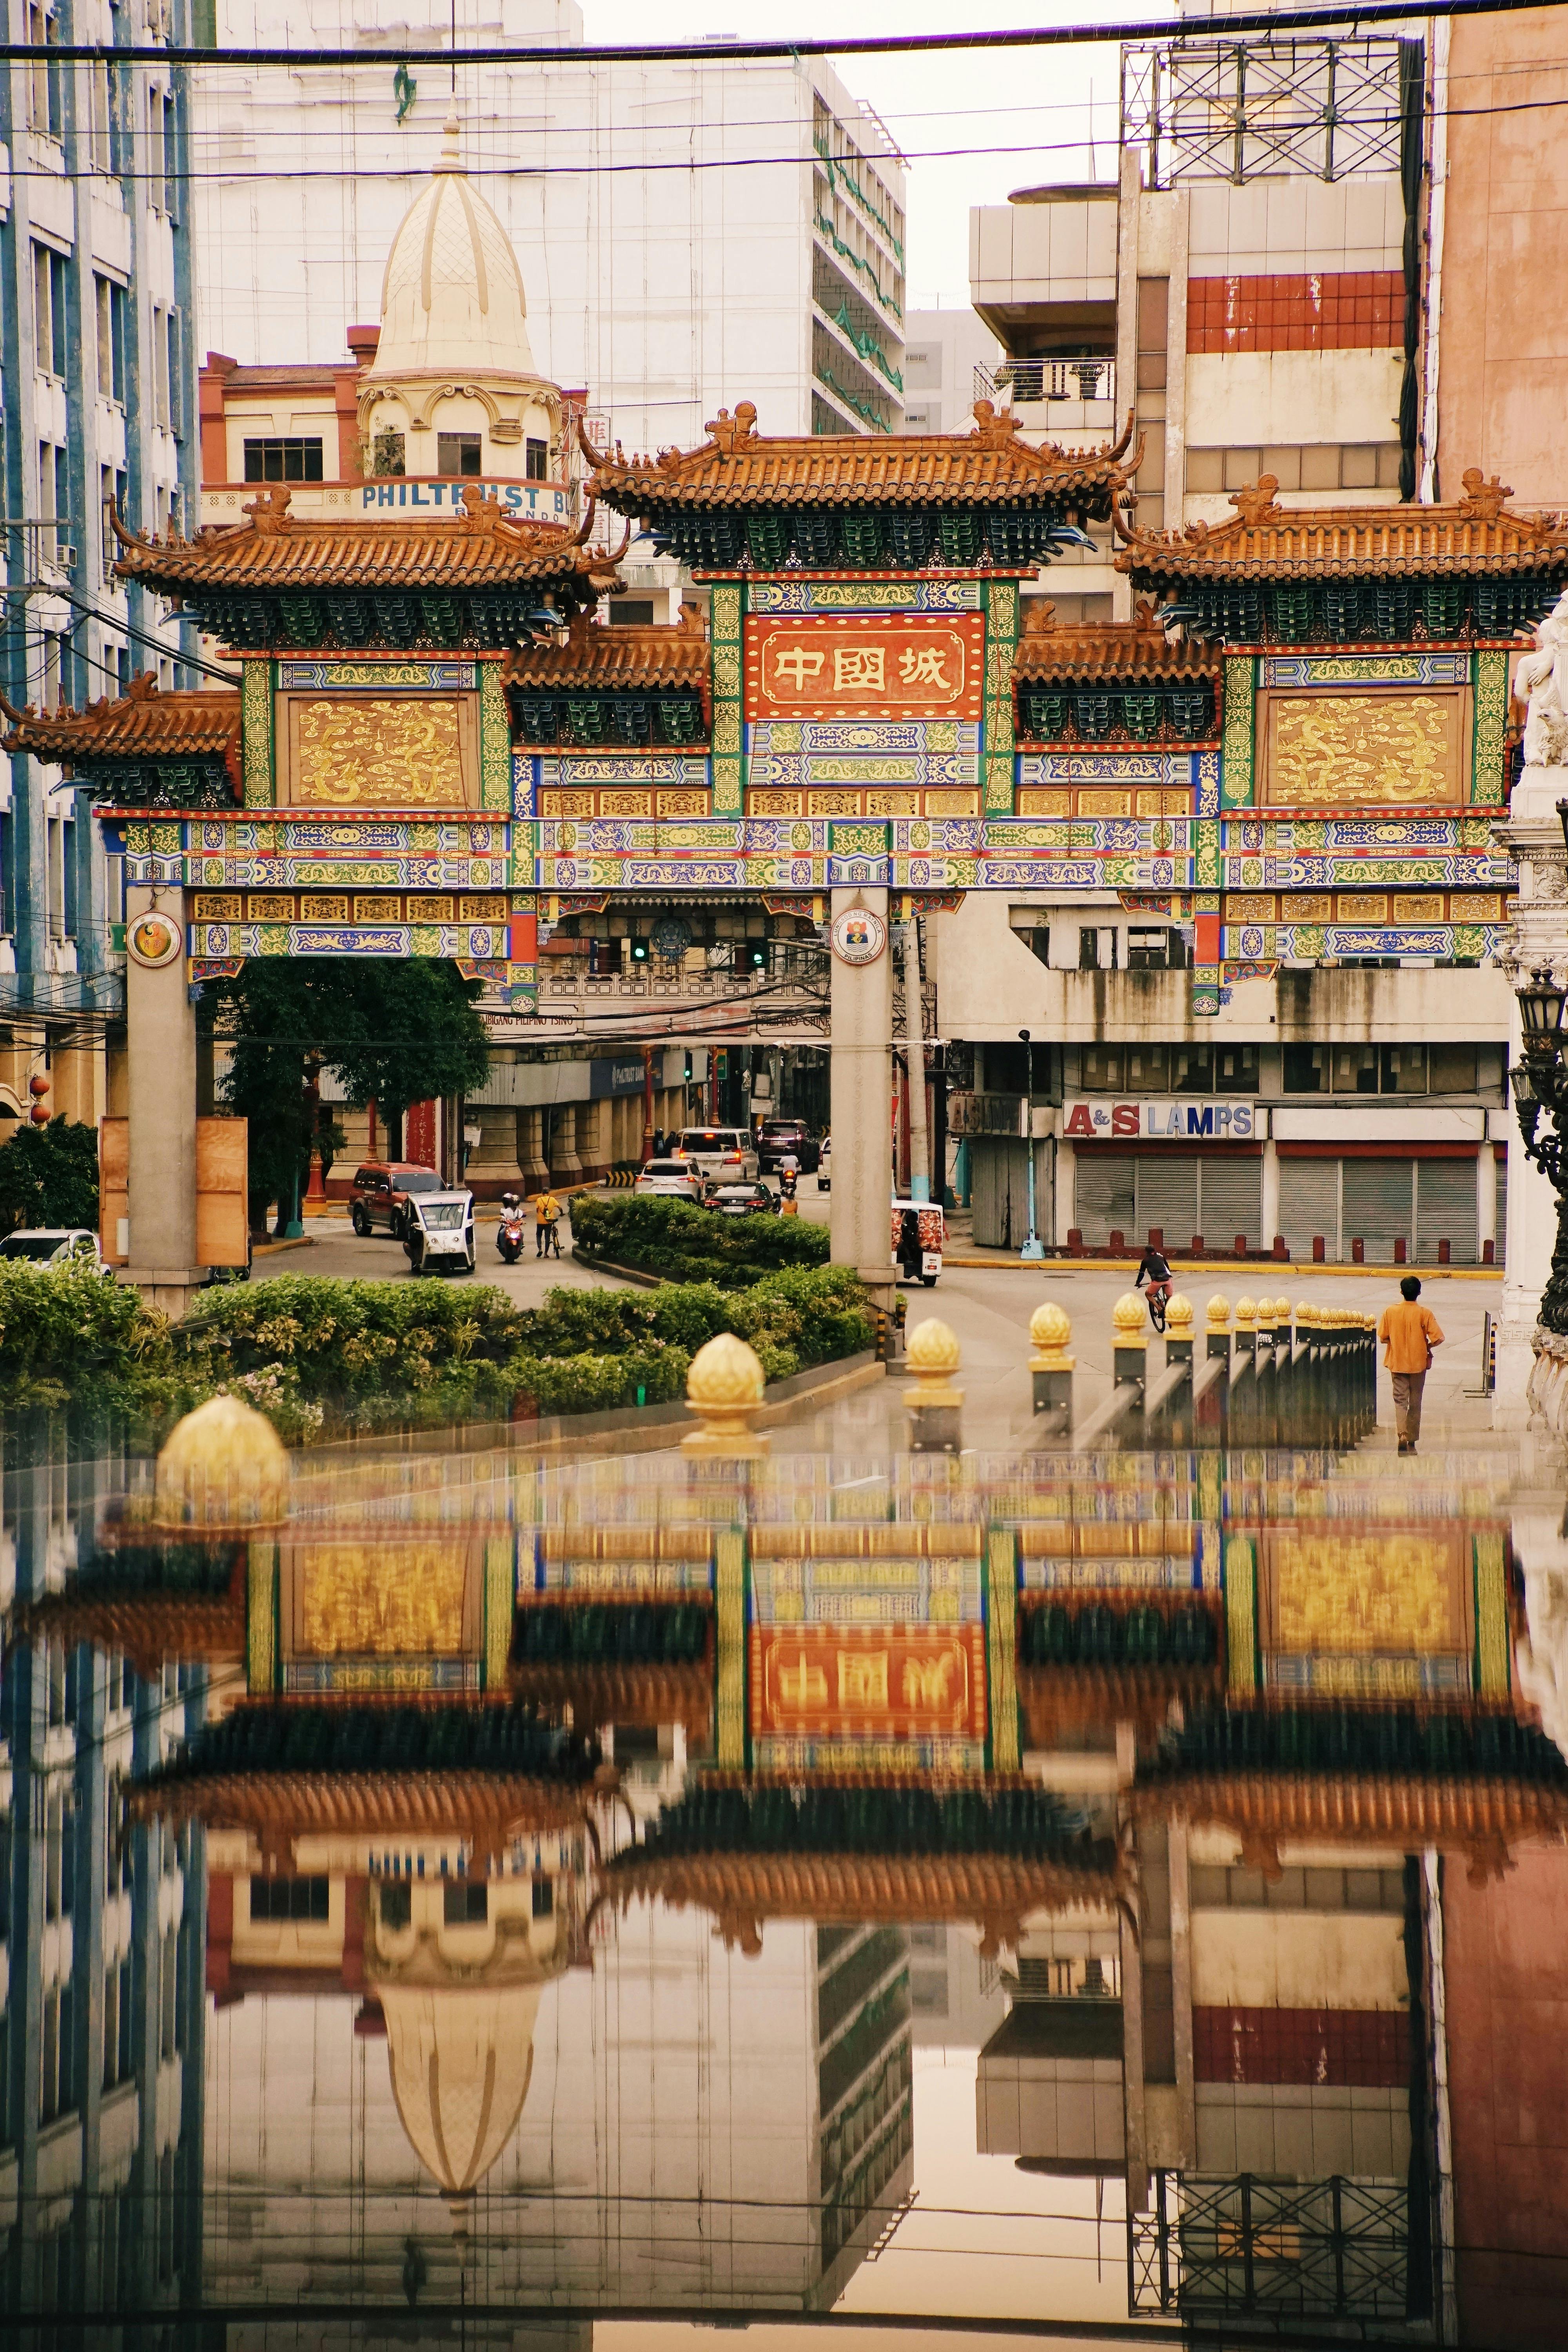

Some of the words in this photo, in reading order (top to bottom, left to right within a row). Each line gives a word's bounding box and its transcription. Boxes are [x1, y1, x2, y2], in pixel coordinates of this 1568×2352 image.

[363, 484, 539, 508] PHILTRUST
[456, 508, 558, 522] BONDO
[774, 646, 951, 691] 中國城
[833, 912, 852, 936] LUNGSOD
[863, 913, 882, 933] MAYNILA
[844, 953, 873, 961] PILIPINAS
[516, 1016, 546, 1025] PILIPINO
[1064, 1105, 1140, 1135] A&S
[1148, 1107, 1251, 1134] LAMPS
